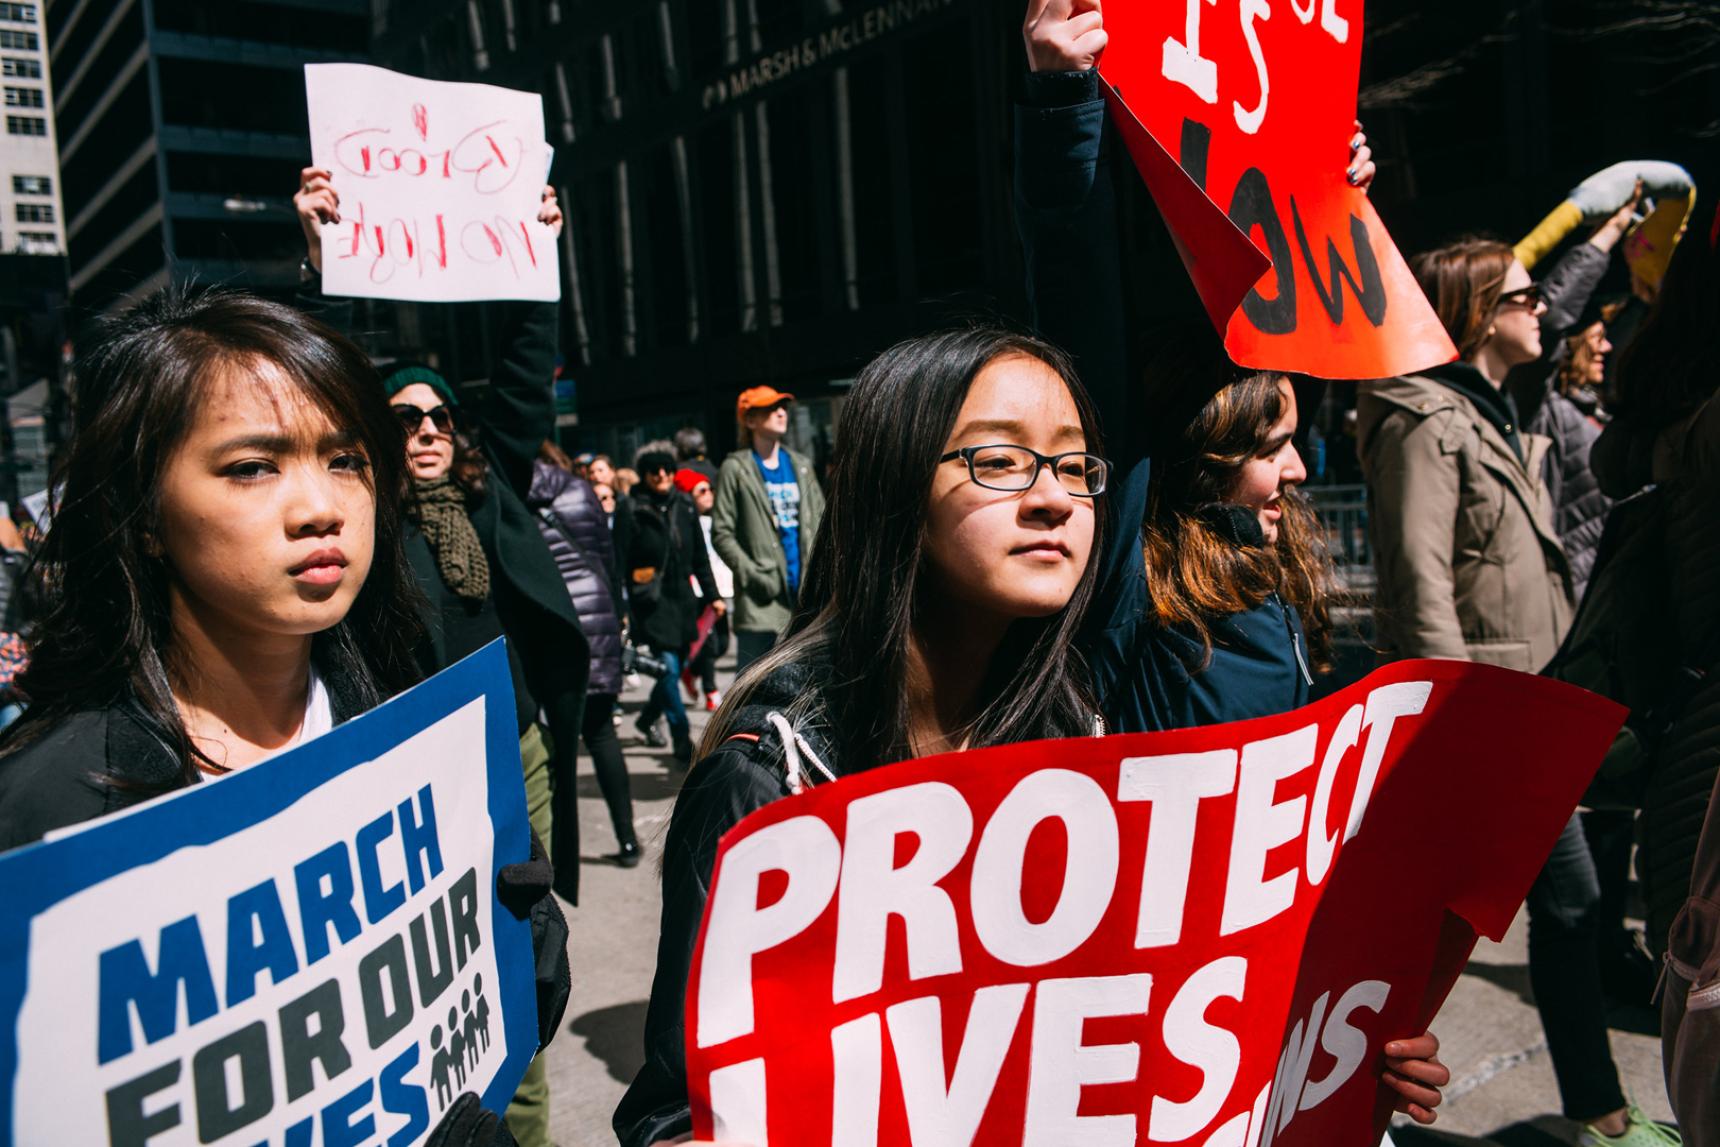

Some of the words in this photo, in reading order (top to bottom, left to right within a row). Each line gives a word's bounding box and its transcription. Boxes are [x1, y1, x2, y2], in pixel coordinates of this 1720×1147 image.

[730, 45, 799, 98] MARSH
[802, 37, 817, 67] &
[334, 119, 527, 194] BLOOD
[336, 202, 447, 284] MORE
[460, 214, 537, 280] NO
[698, 681, 1433, 1048] PROTECT
[98, 782, 444, 1067] MARCH
[105, 977, 352, 1147] FOR
[358, 866, 481, 1051] OUR
